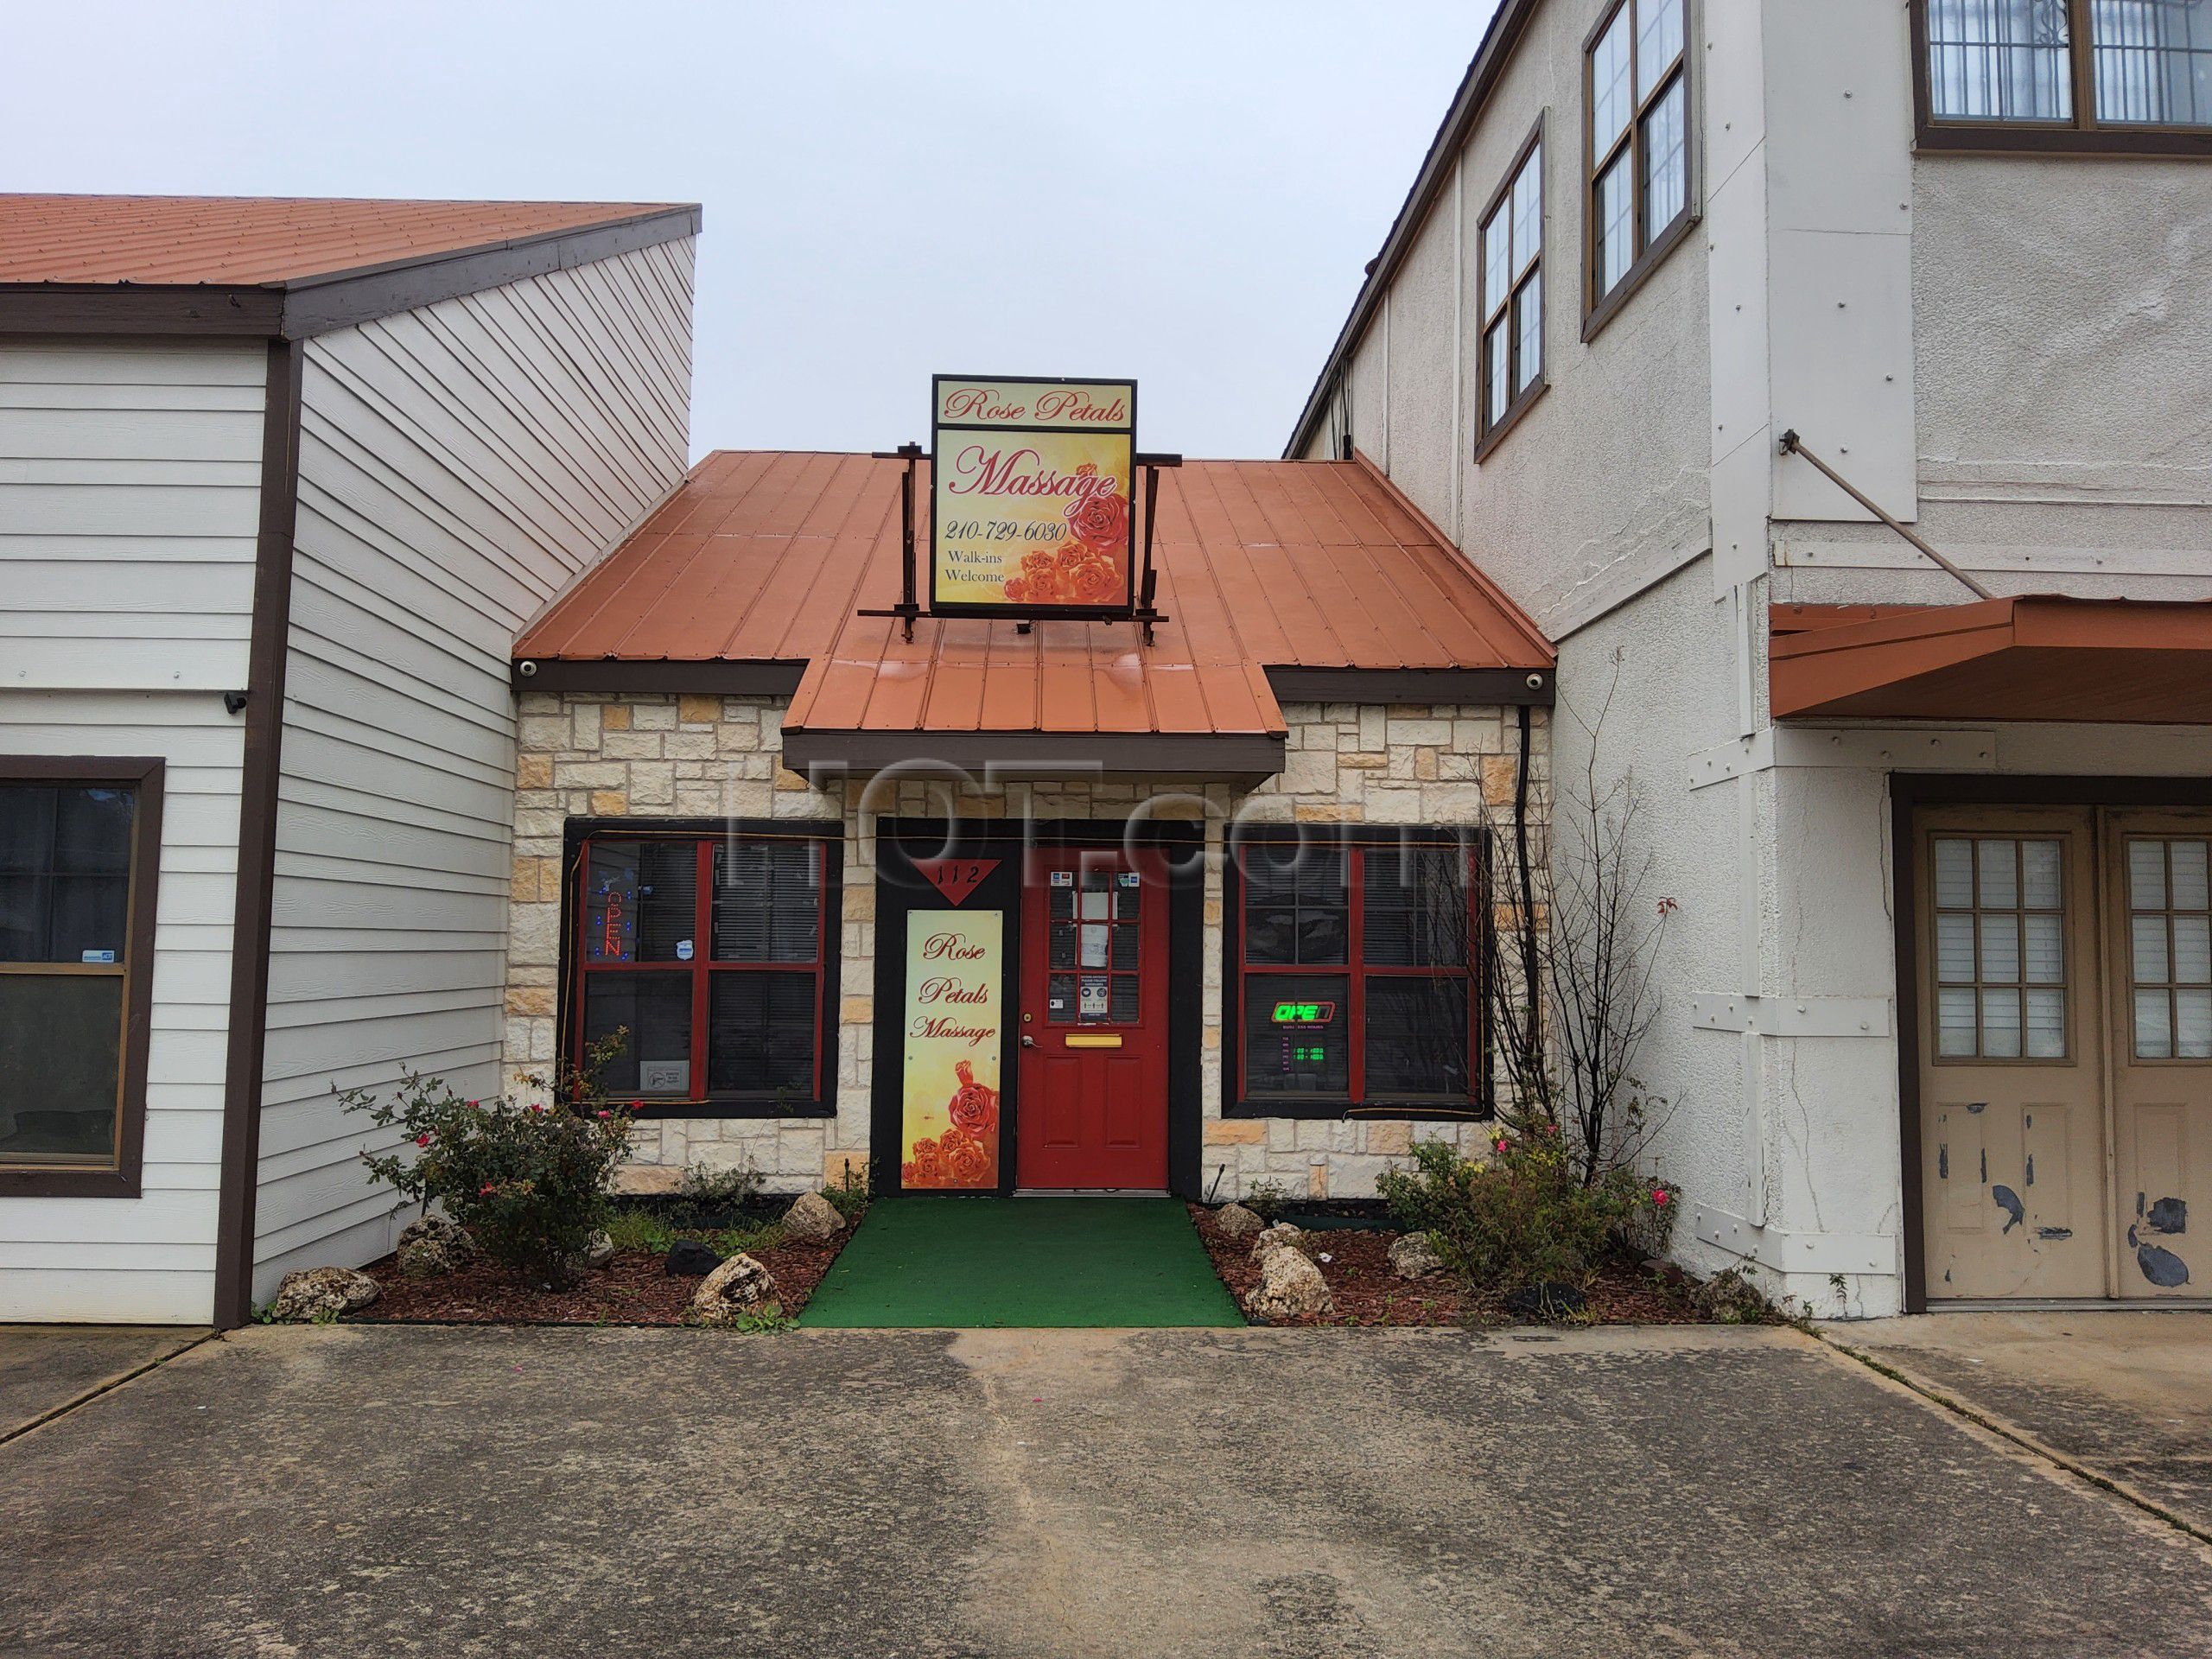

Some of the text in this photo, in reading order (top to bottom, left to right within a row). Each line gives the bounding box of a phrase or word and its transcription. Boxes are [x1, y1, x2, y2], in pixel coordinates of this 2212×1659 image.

[944, 388, 1125, 423] Rose Petals
[948, 445, 1118, 518] Massage
[944, 520, 1068, 543] 210-729-6030
[948, 550, 1002, 564] Walk-ins
[945, 569, 1005, 582] Welcome
[605, 891, 622, 957] OPEN
[923, 932, 986, 961] Rose
[918, 976, 988, 1004] Petals
[1274, 1005, 1331, 1021] OPEN
[910, 1015, 995, 1047] Massage
